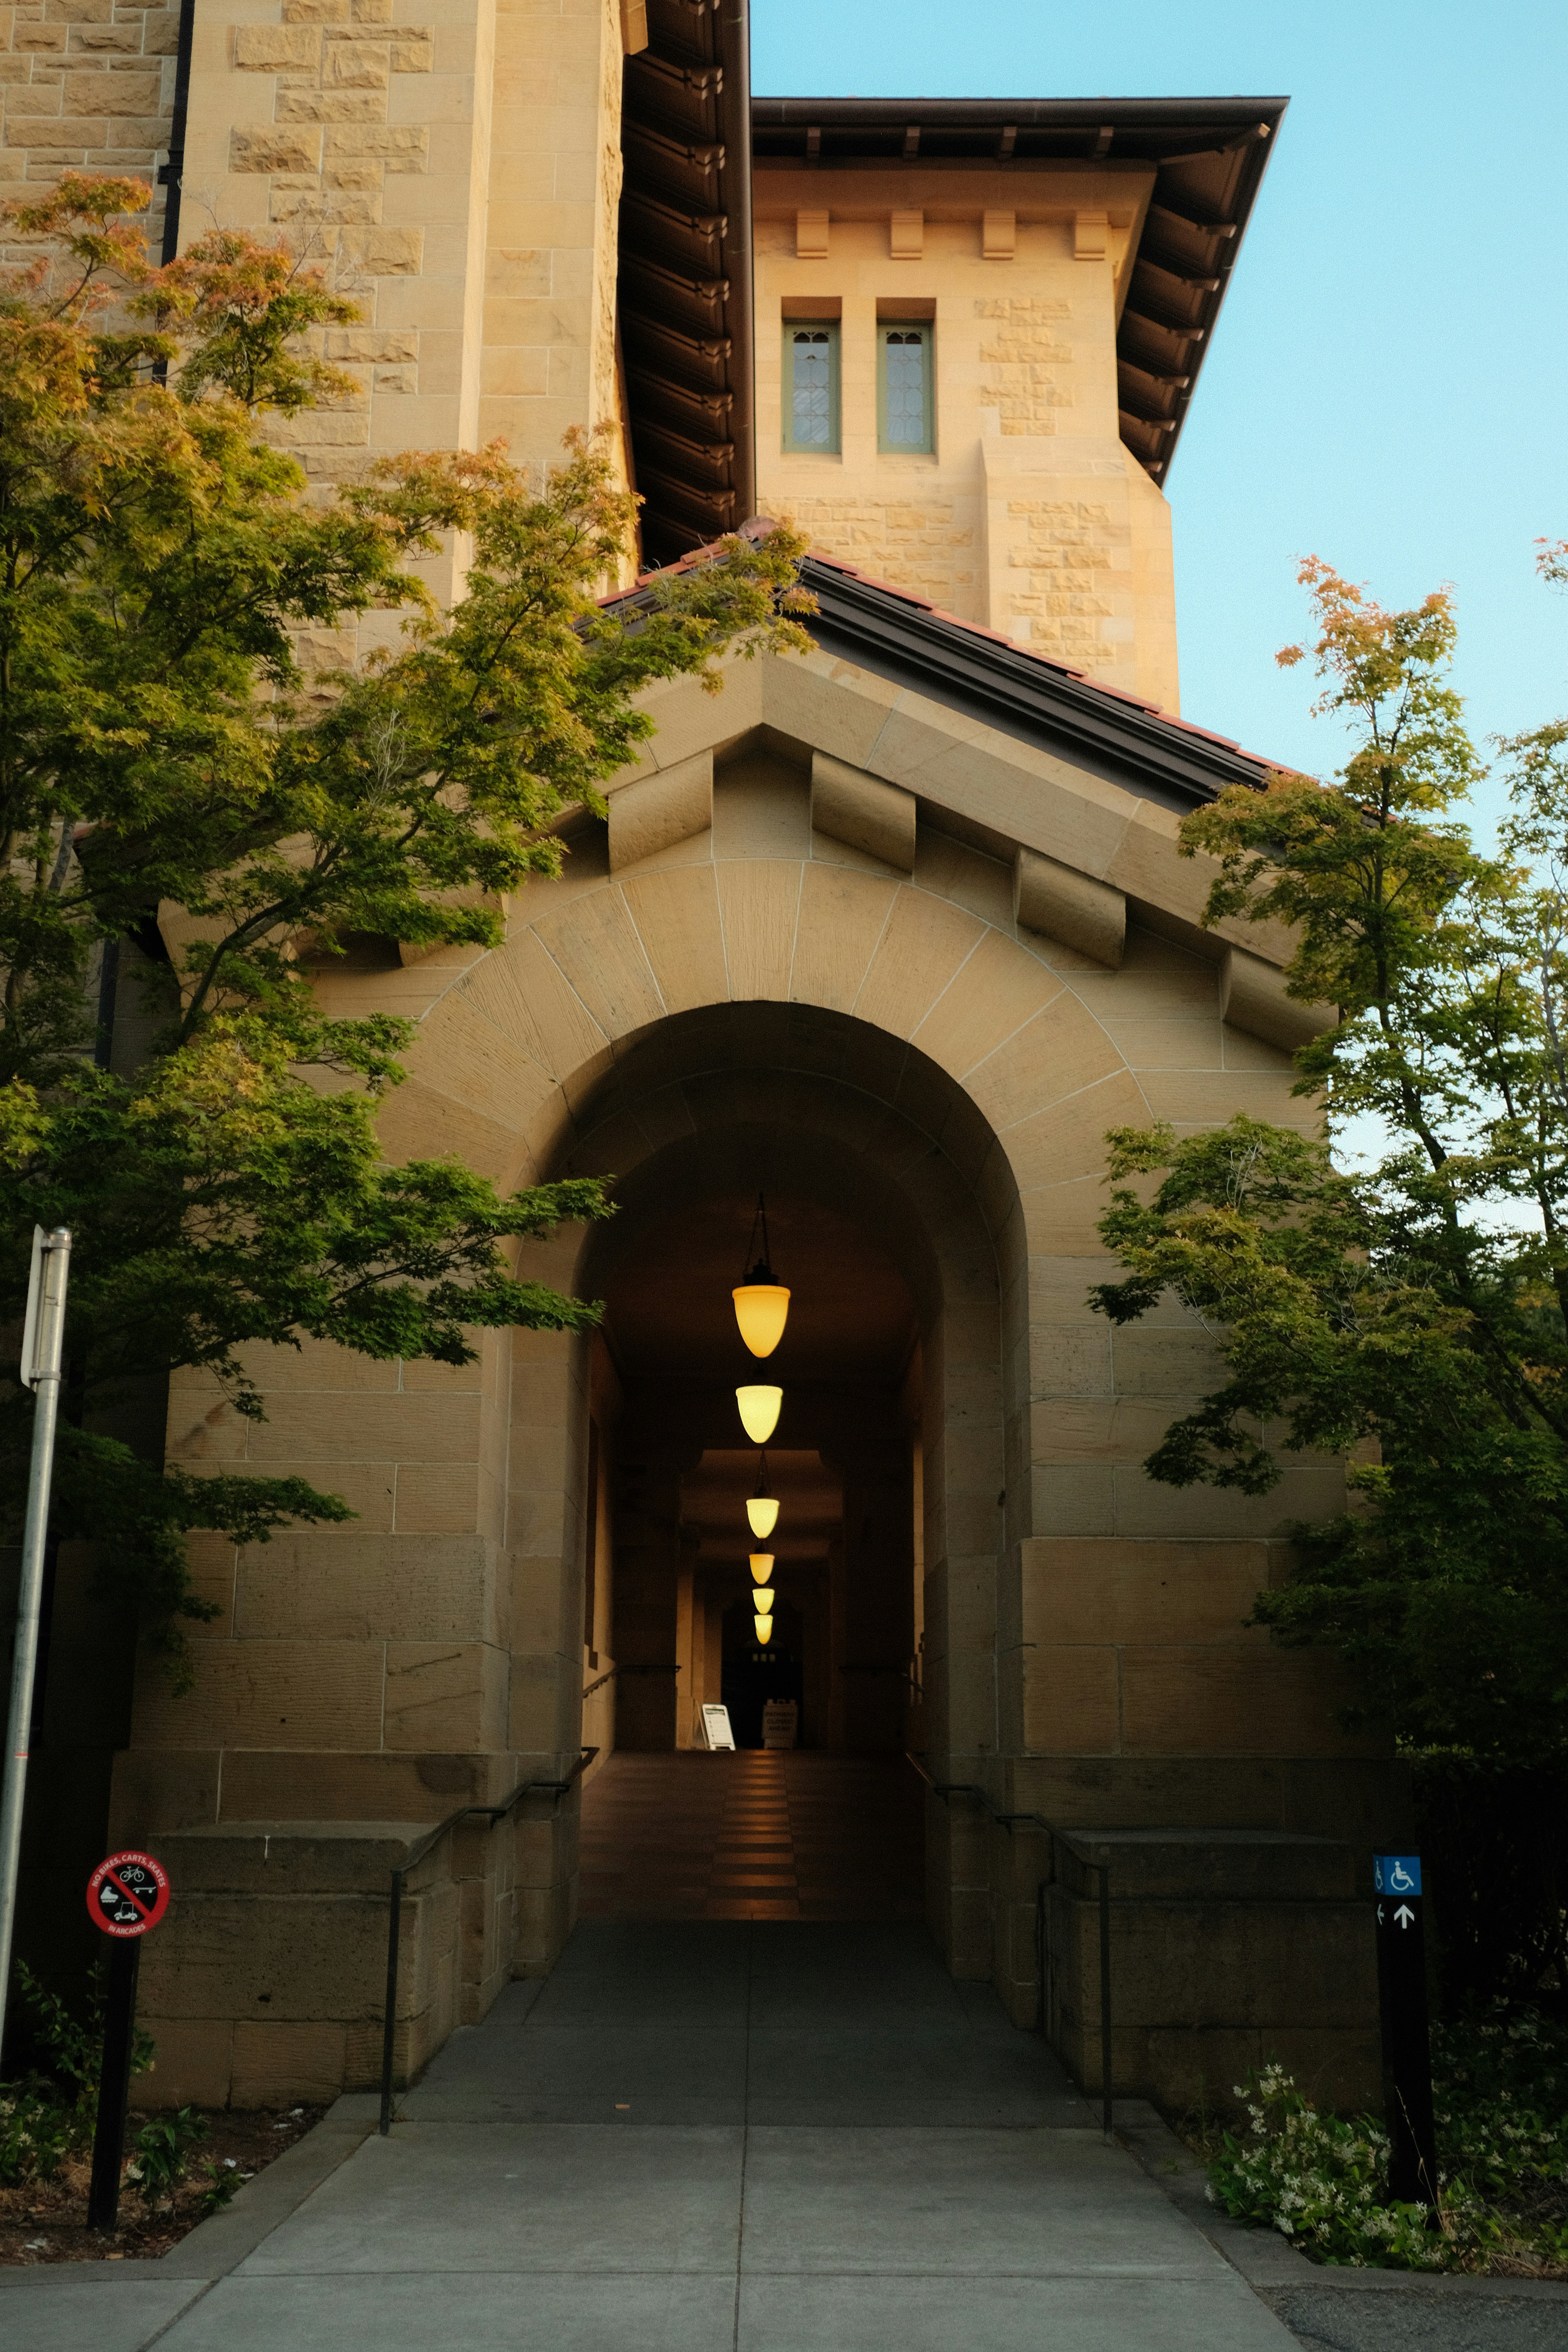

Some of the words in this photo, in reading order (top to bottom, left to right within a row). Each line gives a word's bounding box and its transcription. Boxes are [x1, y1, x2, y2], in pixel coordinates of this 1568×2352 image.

[92, 1874, 101, 1887] NO
[99, 1857, 121, 1875] BIKES,
[122, 1854, 147, 1865] CARTS,
[147, 1861, 166, 1887] SKATES
[108, 1925, 116, 1933] IN
[116, 1923, 145, 1935] ARCADES
